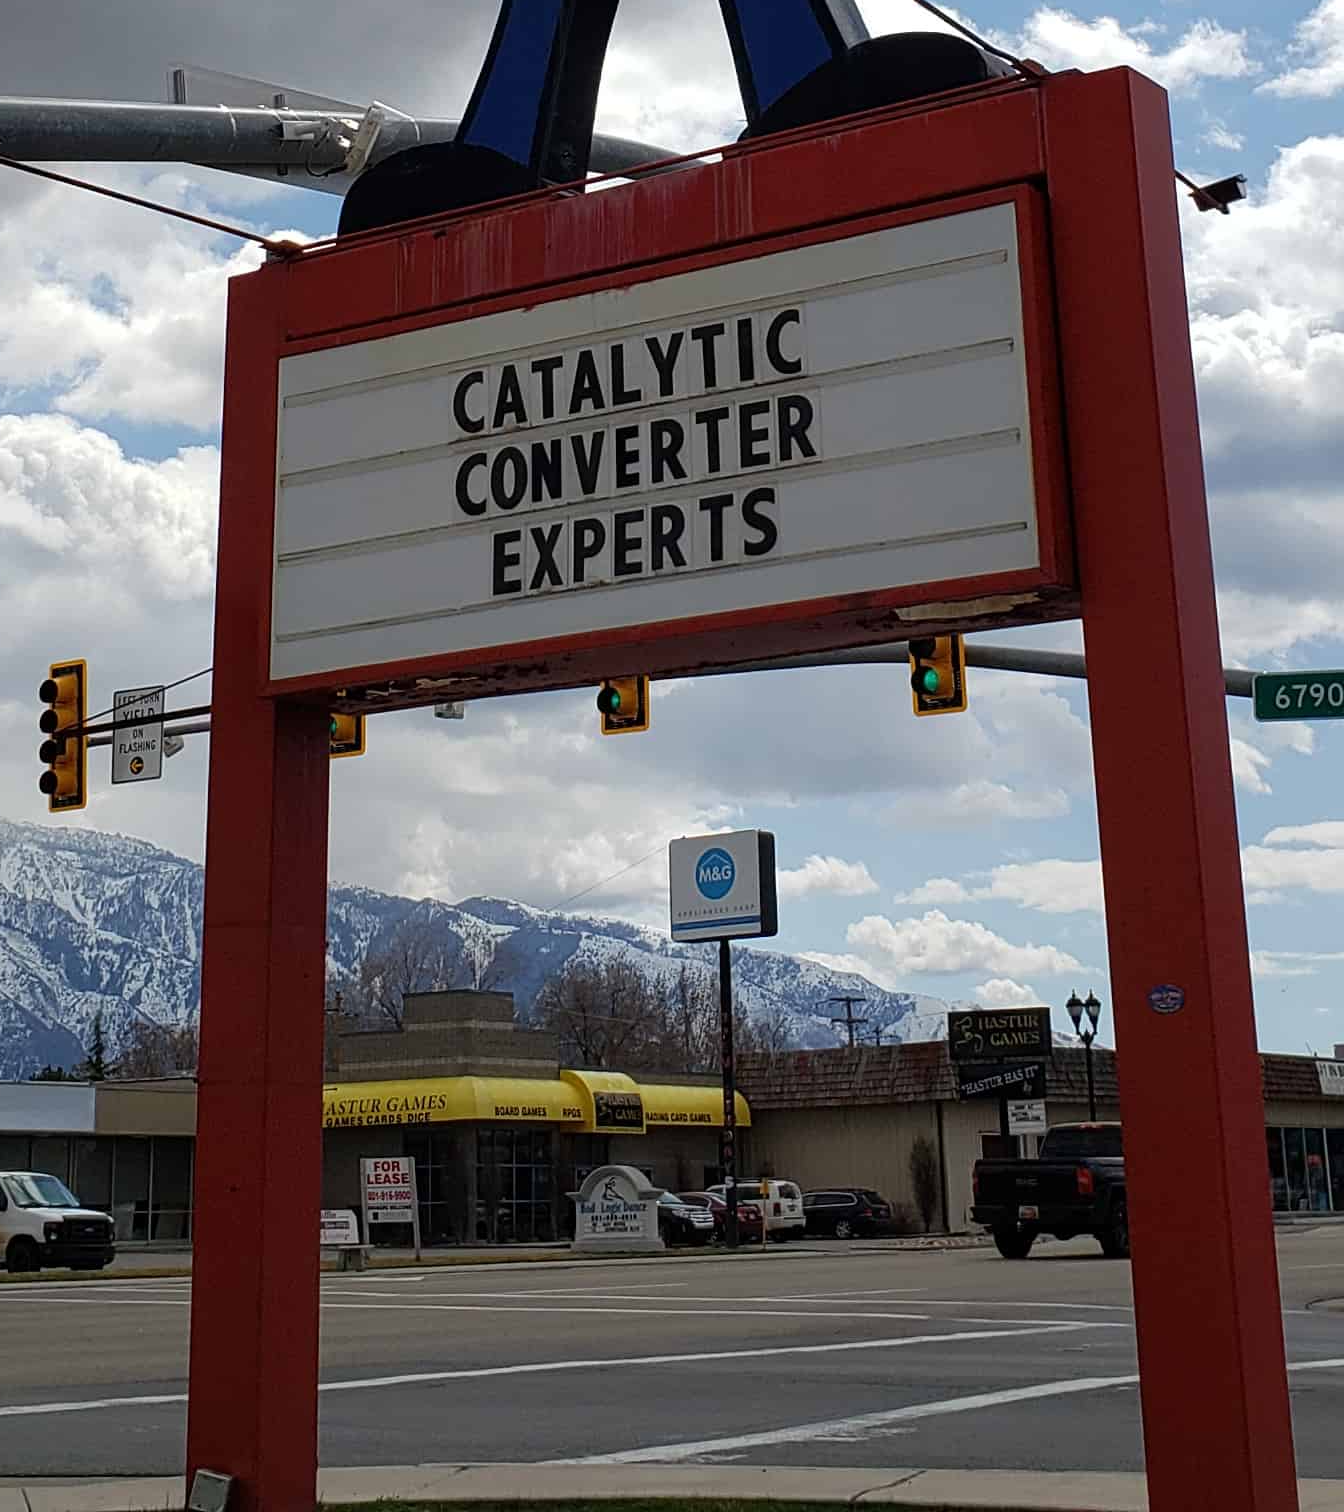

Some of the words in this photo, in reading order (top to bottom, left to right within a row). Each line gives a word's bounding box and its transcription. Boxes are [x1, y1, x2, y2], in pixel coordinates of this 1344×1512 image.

[453, 308, 805, 434] CATALYTIC
[455, 394, 816, 516] CONVERTER
[492, 486, 778, 596] EXPERTS
[1274, 682, 1344, 709] 6790
[132, 728, 144, 739] ON
[119, 740, 156, 754] FLASHING
[699, 865, 733, 883] M&G
[978, 1015, 1039, 1030] HASTUR
[990, 1031, 1040, 1046] GAMES
[324, 1096, 382, 1116] ASTUR
[386, 1094, 447, 1113] GAMES
[494, 1106, 520, 1117] BOARD
[522, 1106, 547, 1117] GAMES
[325, 1114, 363, 1127] GAMES
[366, 1112, 402, 1125] CARDS
[407, 1111, 431, 1123] DICE
[562, 1108, 582, 1119] RPGS
[645, 1112, 669, 1122] RADING
[671, 1111, 687, 1122] CARD
[689, 1112, 712, 1123] GAMES
[373, 1161, 401, 1172] FOR
[367, 1172, 410, 1185] LEASE
